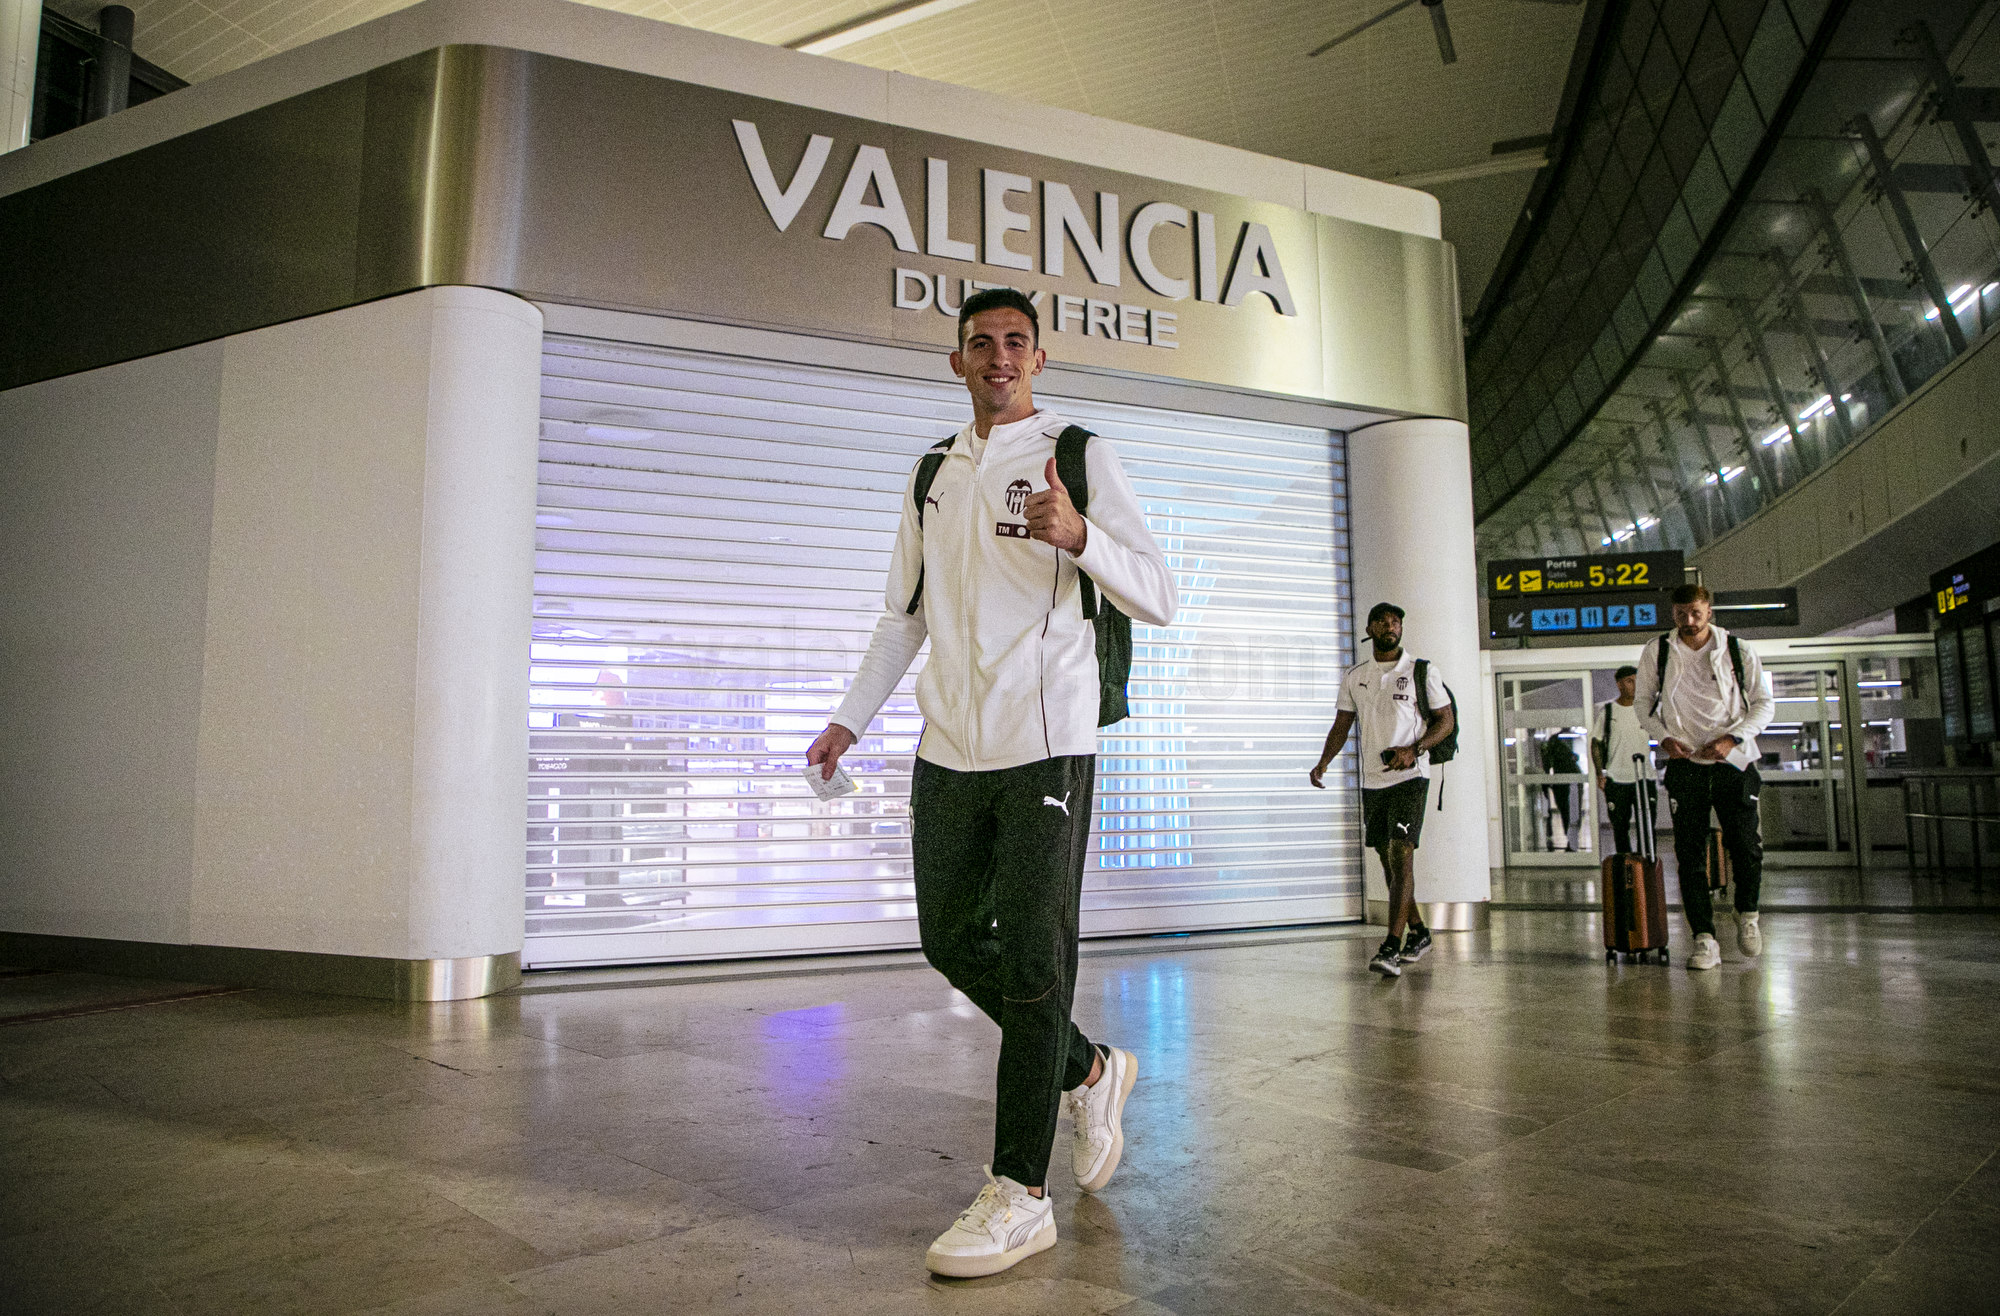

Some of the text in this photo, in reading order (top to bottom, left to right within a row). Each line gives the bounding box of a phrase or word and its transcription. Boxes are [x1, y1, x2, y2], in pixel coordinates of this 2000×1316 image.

[731, 118, 1297, 317] VALENCIA
[895, 267, 1180, 349] DU FREE
[998, 525, 1010, 535] TM
[1546, 560, 1577, 569] Portes
[1589, 565, 1605, 587] 5
[1616, 562, 1649, 585] 22
[1547, 580, 1584, 589] Puertas
